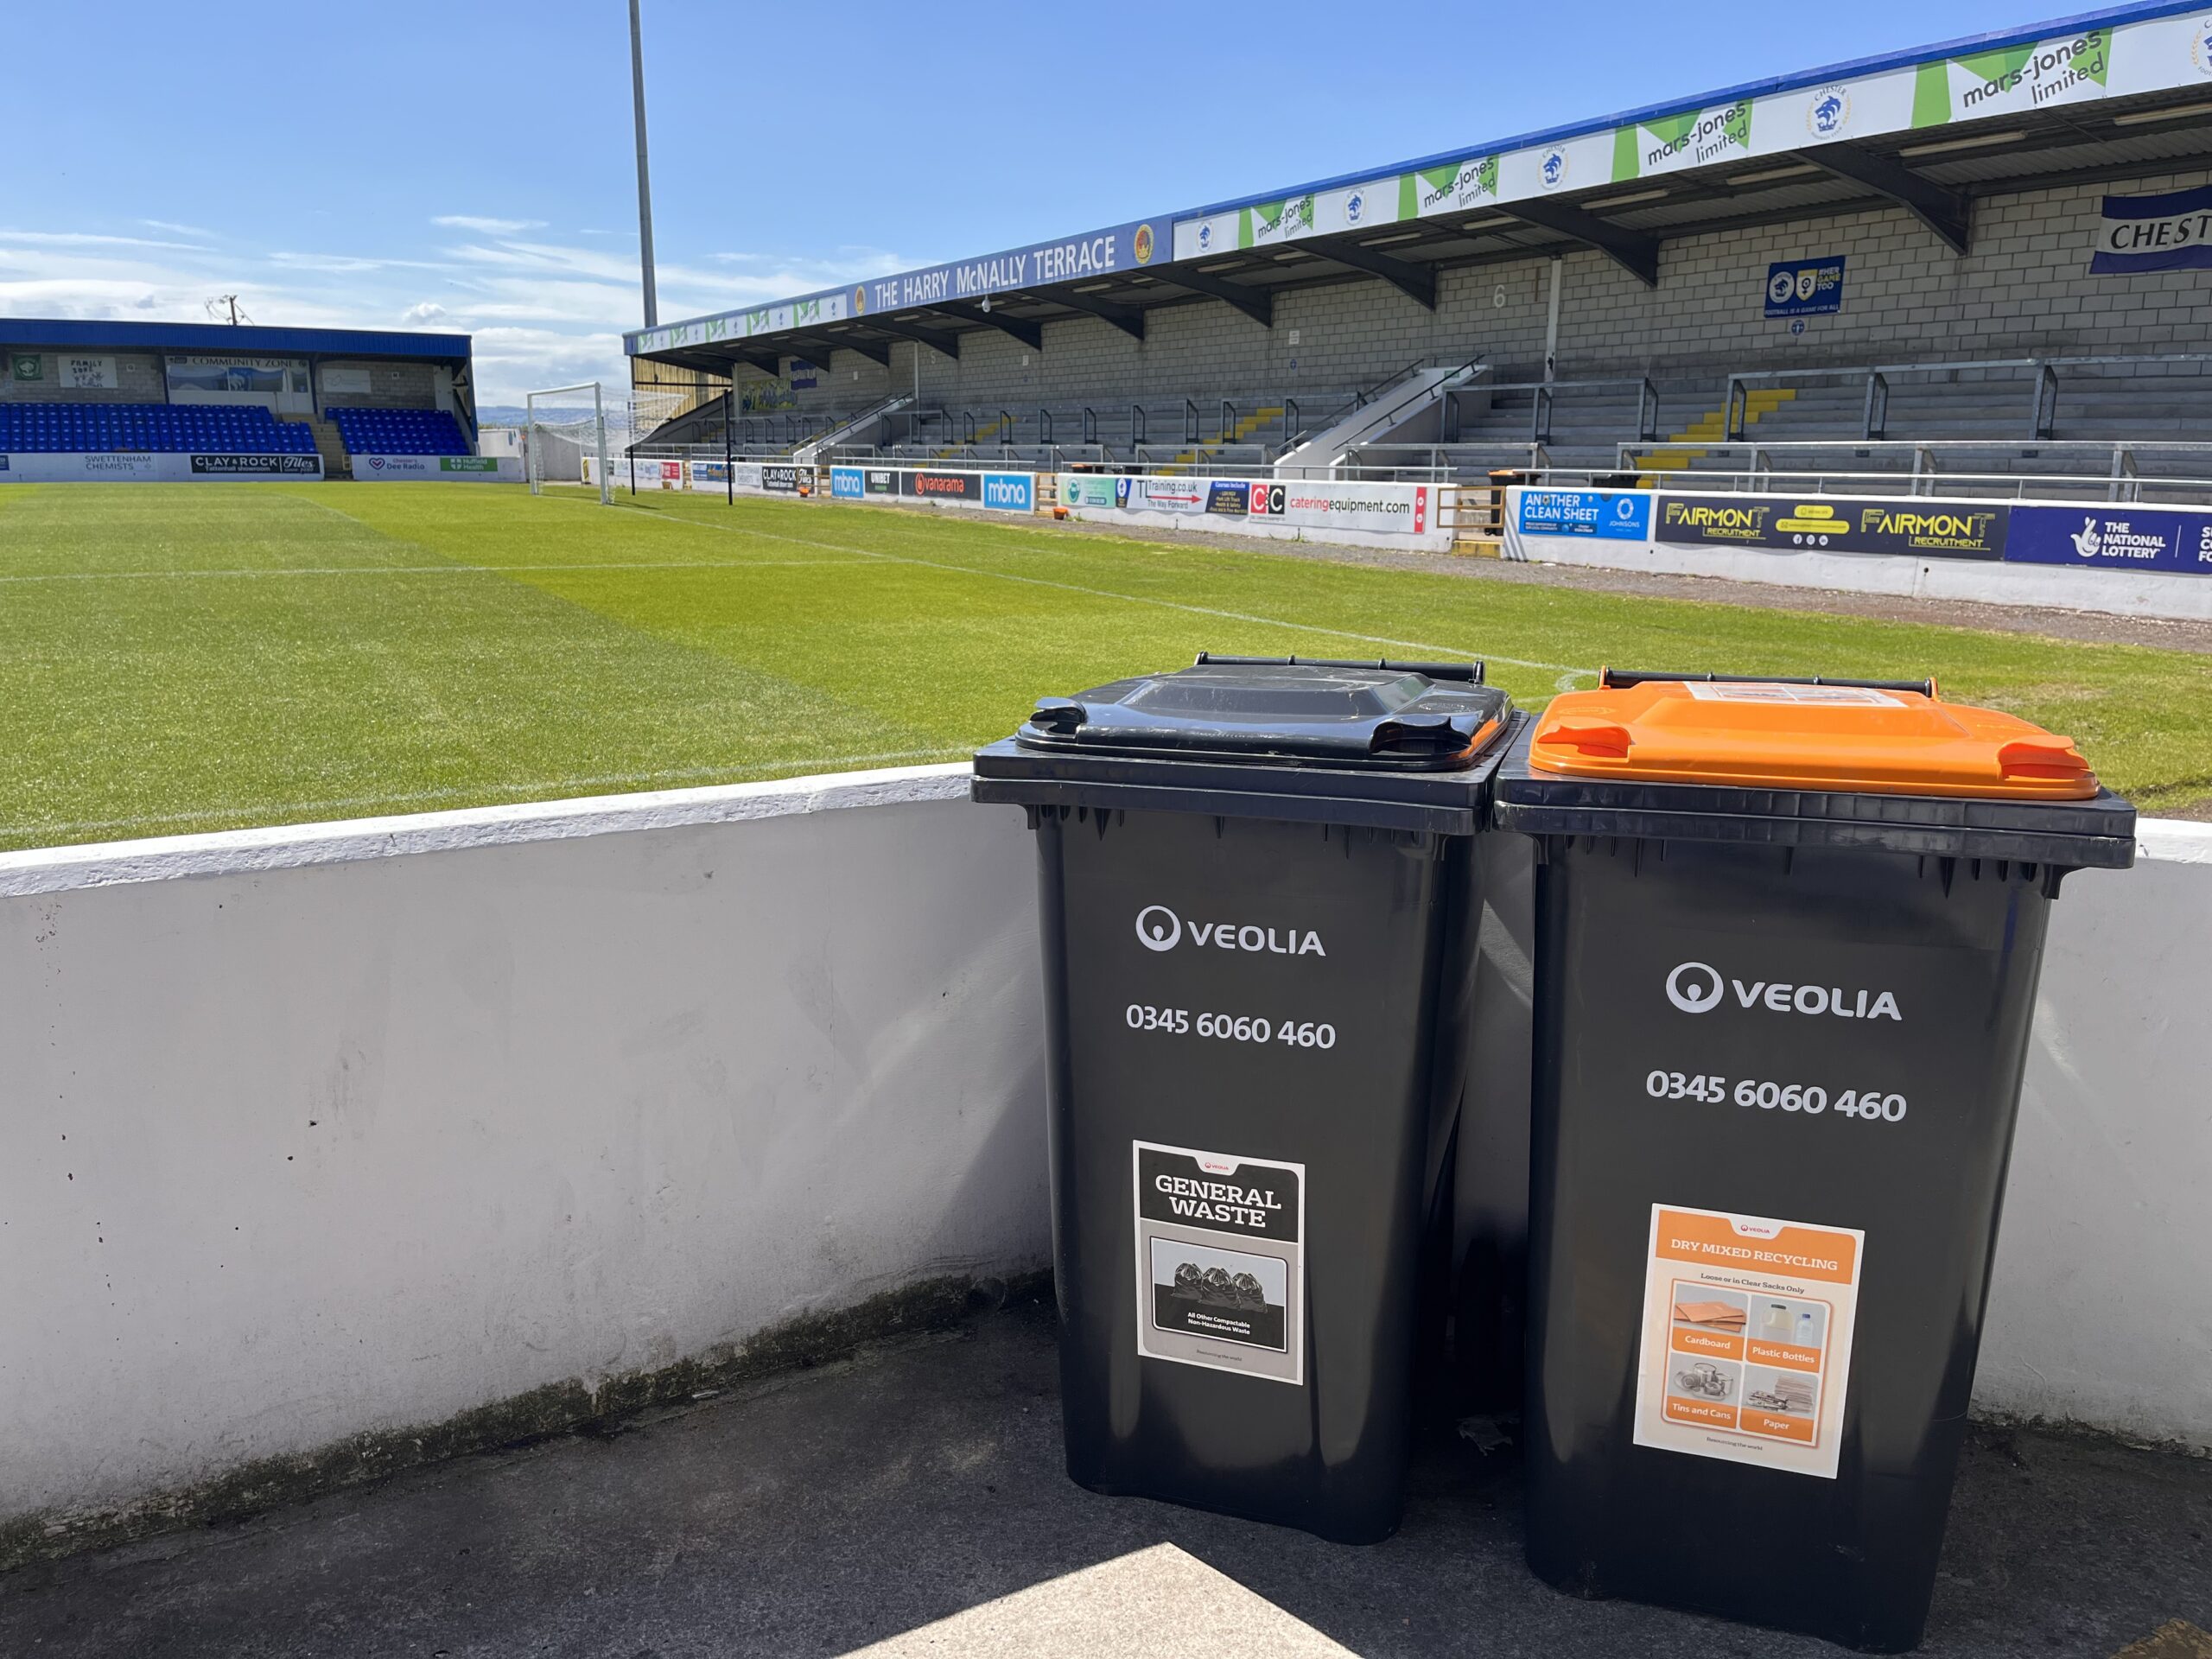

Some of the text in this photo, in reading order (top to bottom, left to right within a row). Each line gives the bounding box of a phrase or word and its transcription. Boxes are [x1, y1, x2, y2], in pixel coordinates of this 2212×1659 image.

[1963, 31, 2102, 108] mars-jones
[2031, 51, 2105, 105] limited
[1648, 103, 1745, 165] mars-jones
[1696, 119, 1747, 163] limited
[1424, 157, 1494, 207] mars-jones
[1459, 172, 1496, 207] limited
[1258, 196, 1311, 238] mars-jones
[1285, 208, 1313, 239] limited
[2111, 214, 2212, 249] CHEST
[875, 235, 1115, 308] THE HARRY McNALLY TERRACE
[1494, 284, 1505, 308] 6
[193, 358, 262, 366] COMMUNITY
[86, 462, 134, 471] CHEMISTS
[195, 457, 229, 467] CLAY
[239, 457, 277, 467] ROCK
[763, 469, 777, 480] CLAY
[780, 469, 797, 481] ROCK
[835, 473, 860, 493] mbna
[871, 473, 890, 484] UNIBET
[925, 478, 965, 493] vanarama
[988, 479, 1026, 504] mbna
[1147, 499, 1188, 510] The Way Forward
[1290, 496, 1409, 513] cateringequipment.com
[1525, 506, 1599, 521] CLEAN SHEET
[1666, 503, 1770, 528] FAIRMONT
[1861, 509, 1995, 537] FAIRMONT
[1707, 527, 1761, 537] RECRUITMENT
[2105, 522, 2130, 533] THE
[1914, 537, 1983, 548] RECRUITMENT
[2103, 534, 2166, 548] NATIONAL
[2101, 545, 2160, 559] LOTTERY
[1187, 920, 1326, 957] VEOLIA
[1732, 979, 1903, 1021] VEOLIA
[1126, 1004, 1336, 1049] 0345 6060 460
[1646, 1070, 1907, 1122] 0345 6060 460
[1155, 1174, 1281, 1210] GENERAL
[1168, 1196, 1266, 1228] WASTE
[1671, 1238, 1839, 1271] DRY MIXED RECYCLING
[1700, 1273, 1723, 1282] Loose
[1741, 1279, 1761, 1287] Clear
[1763, 1281, 1785, 1291] Sacks
[1786, 1284, 1805, 1294] Only
[1188, 1319, 1250, 1335] Non-Hazardous Waste
[1214, 1316, 1250, 1328] Compactable
[1685, 1335, 1731, 1350] Cardboard
[1752, 1346, 1815, 1363] Plastic Bottles
[1672, 1402, 1731, 1420] Tins and Cans
[1764, 1418, 1789, 1430] Paper
